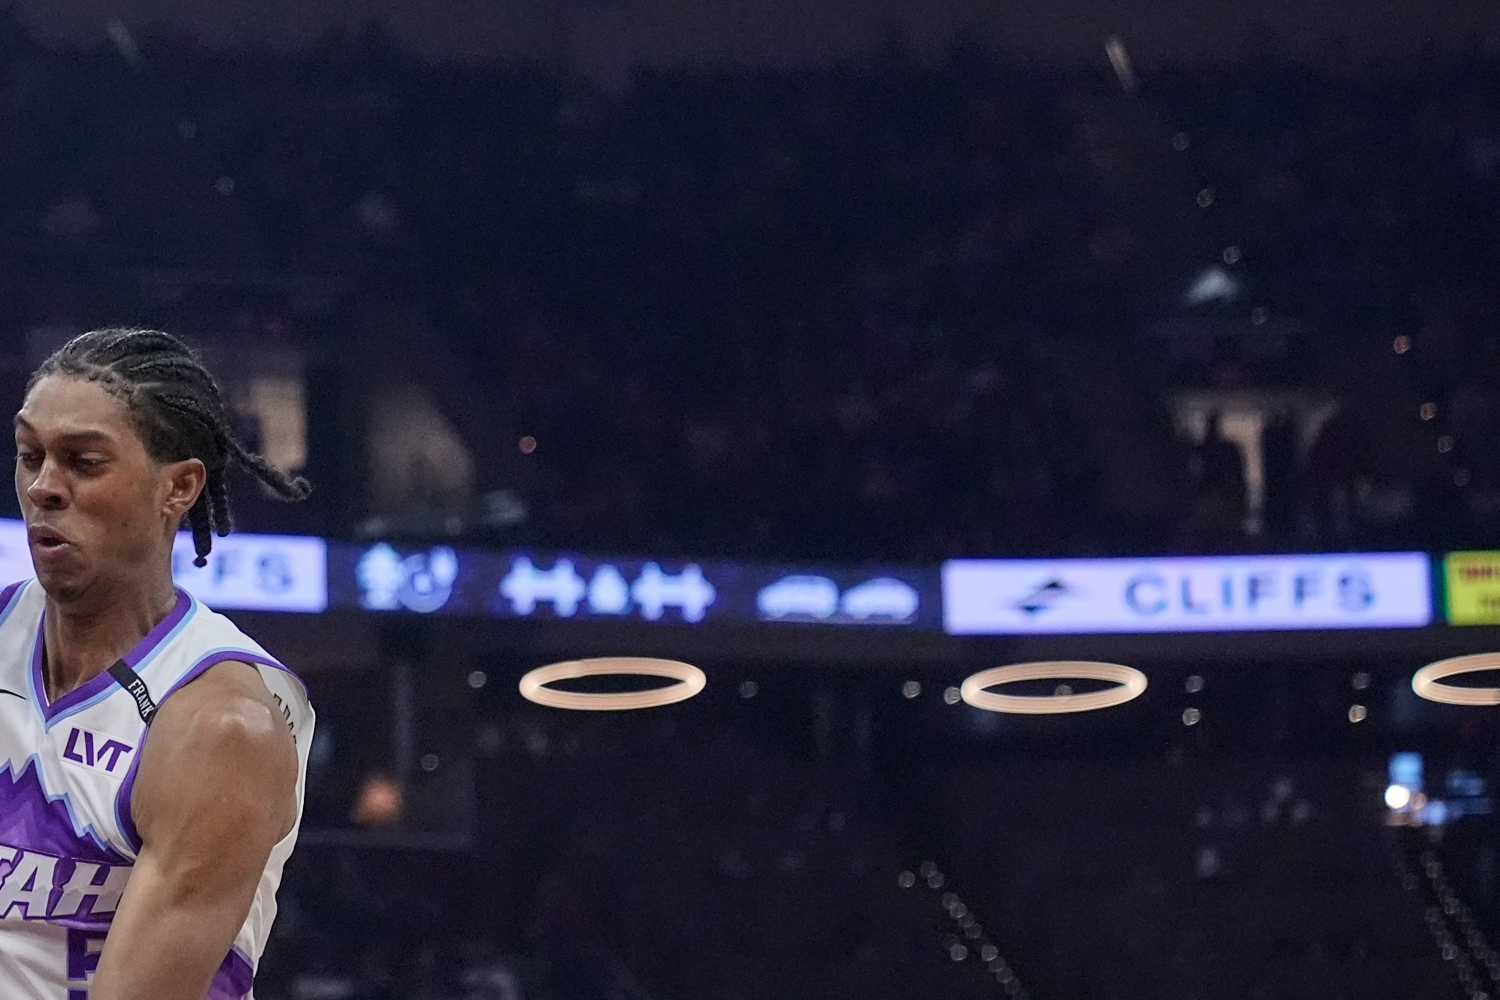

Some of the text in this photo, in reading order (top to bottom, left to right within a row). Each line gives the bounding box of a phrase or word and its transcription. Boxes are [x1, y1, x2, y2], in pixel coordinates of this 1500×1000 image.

[1124, 565, 1377, 616] CLIFFS
[127, 679, 155, 718] FRANK
[62, 727, 134, 772] LVT
